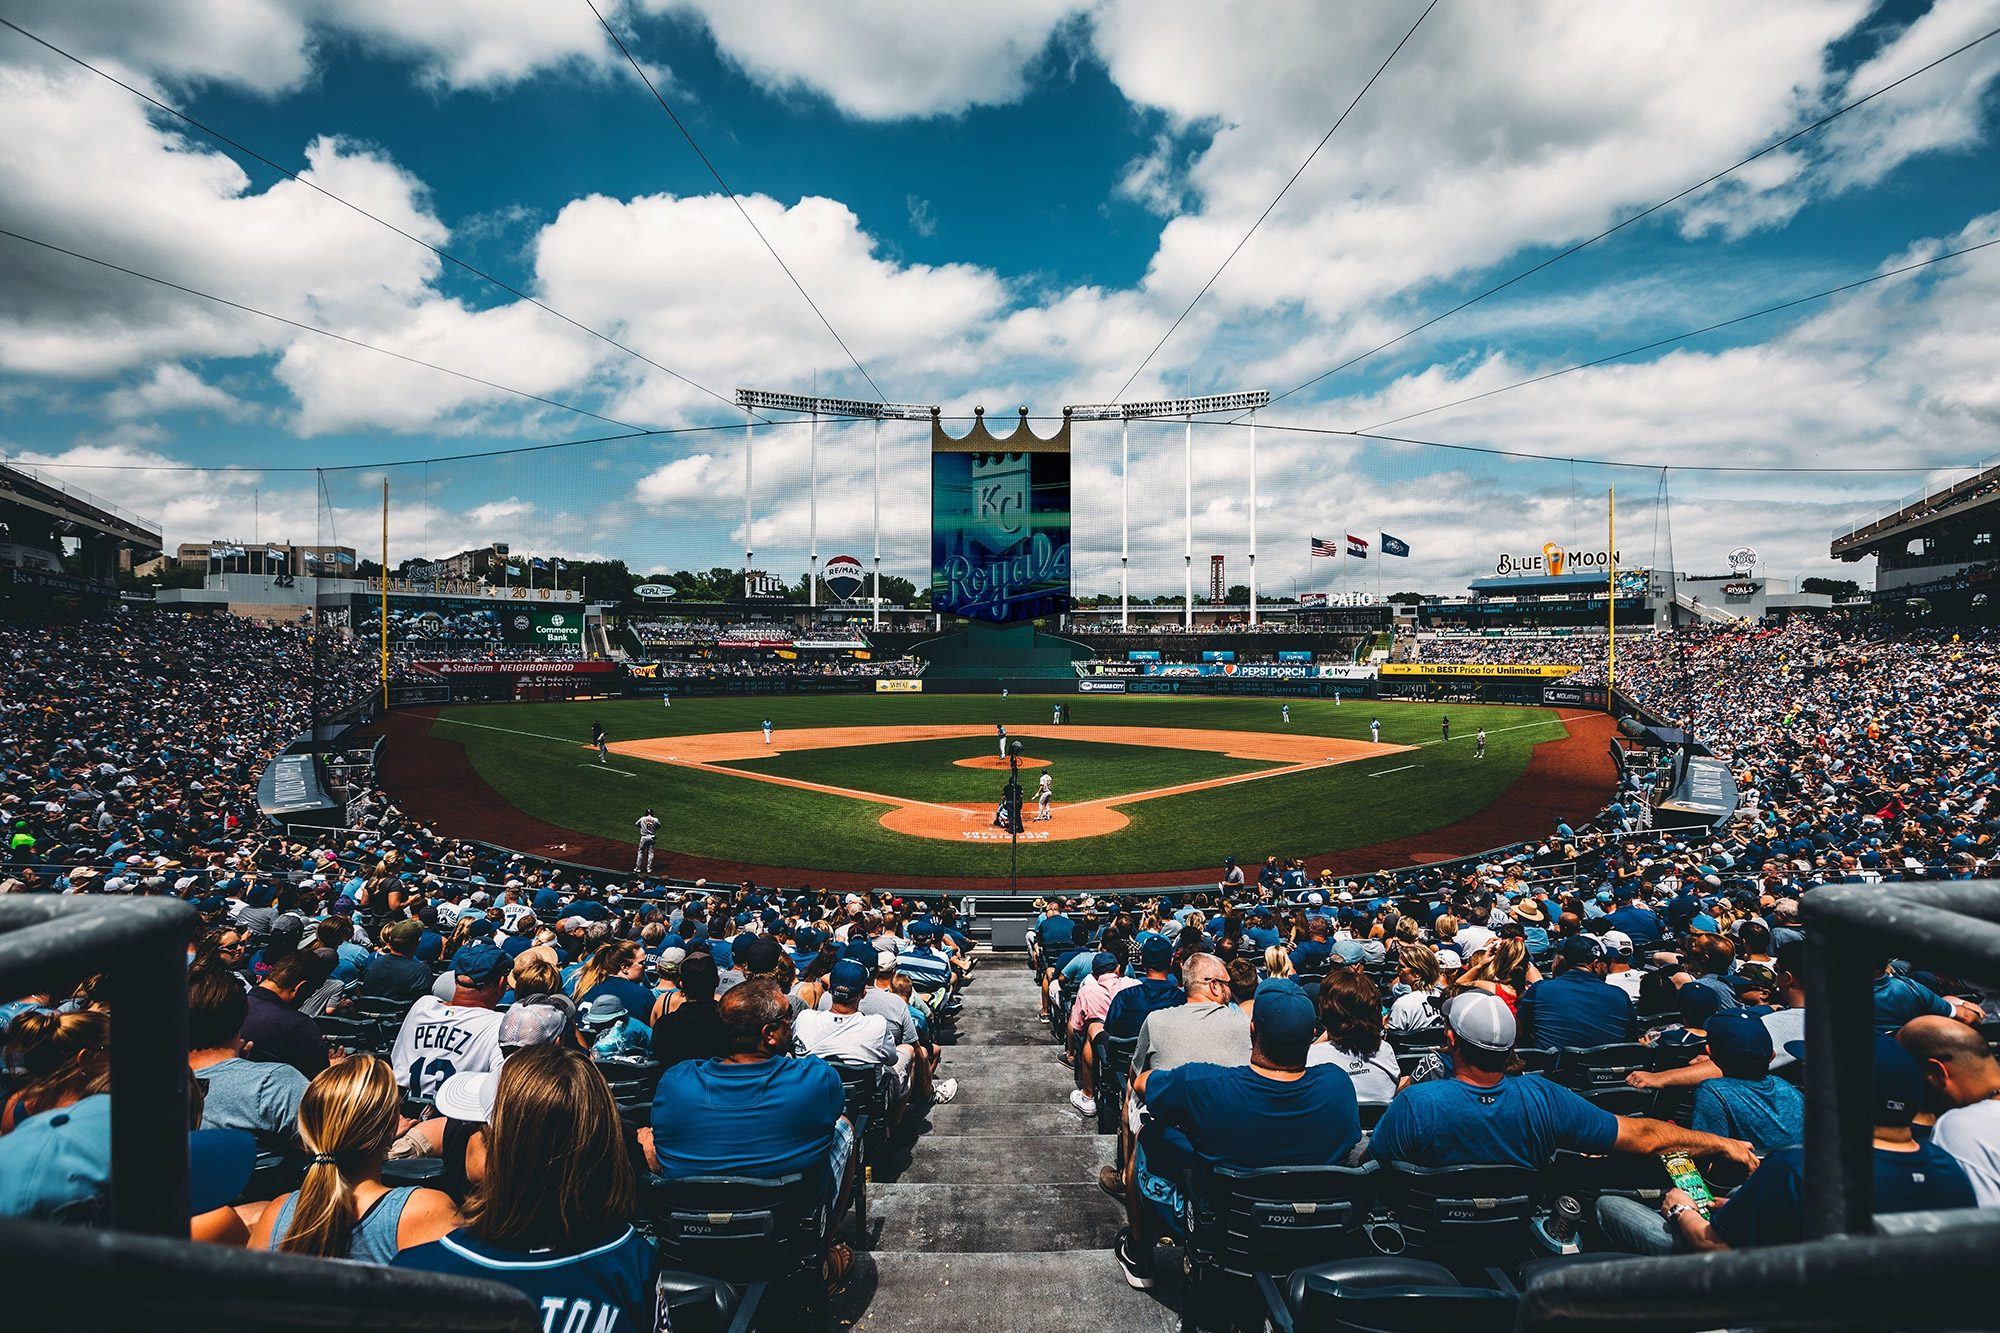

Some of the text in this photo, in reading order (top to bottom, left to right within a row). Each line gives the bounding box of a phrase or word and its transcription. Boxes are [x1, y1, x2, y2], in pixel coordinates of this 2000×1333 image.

[974, 484, 1023, 534] KC
[1496, 551, 1620, 574] BLUE MOON
[1728, 551, 1756, 568] 360
[406, 559, 448, 579] Royals
[828, 567, 860, 576] RE/MAX
[273, 574, 295, 589] 42
[943, 532, 1069, 620] Royals
[367, 576, 418, 593] HALL
[435, 579, 482, 595] FAME
[752, 576, 784, 595] Lite
[1727, 586, 1754, 594] RIVALS
[511, 586, 573, 600] 20 10 5
[1328, 592, 1374, 607] PATIO
[1302, 598, 1326, 608] CHOPPER
[422, 619, 439, 632] 50
[535, 626, 578, 634] Commerce
[499, 663, 574, 672] NEIGHBORHOOD
[1242, 667, 1306, 676] PEPSI PORCH
[1334, 668, 1350, 677] Ivy
[1460, 666, 1480, 674] Price
[1497, 667, 1541, 675] Unlimited
[1129, 683, 1171, 692] GEICO
[1334, 685, 1364, 694] National
[1296, 876, 1303, 887] 4
[507, 914, 517, 929] 7
[415, 1025, 473, 1056] PEREZ
